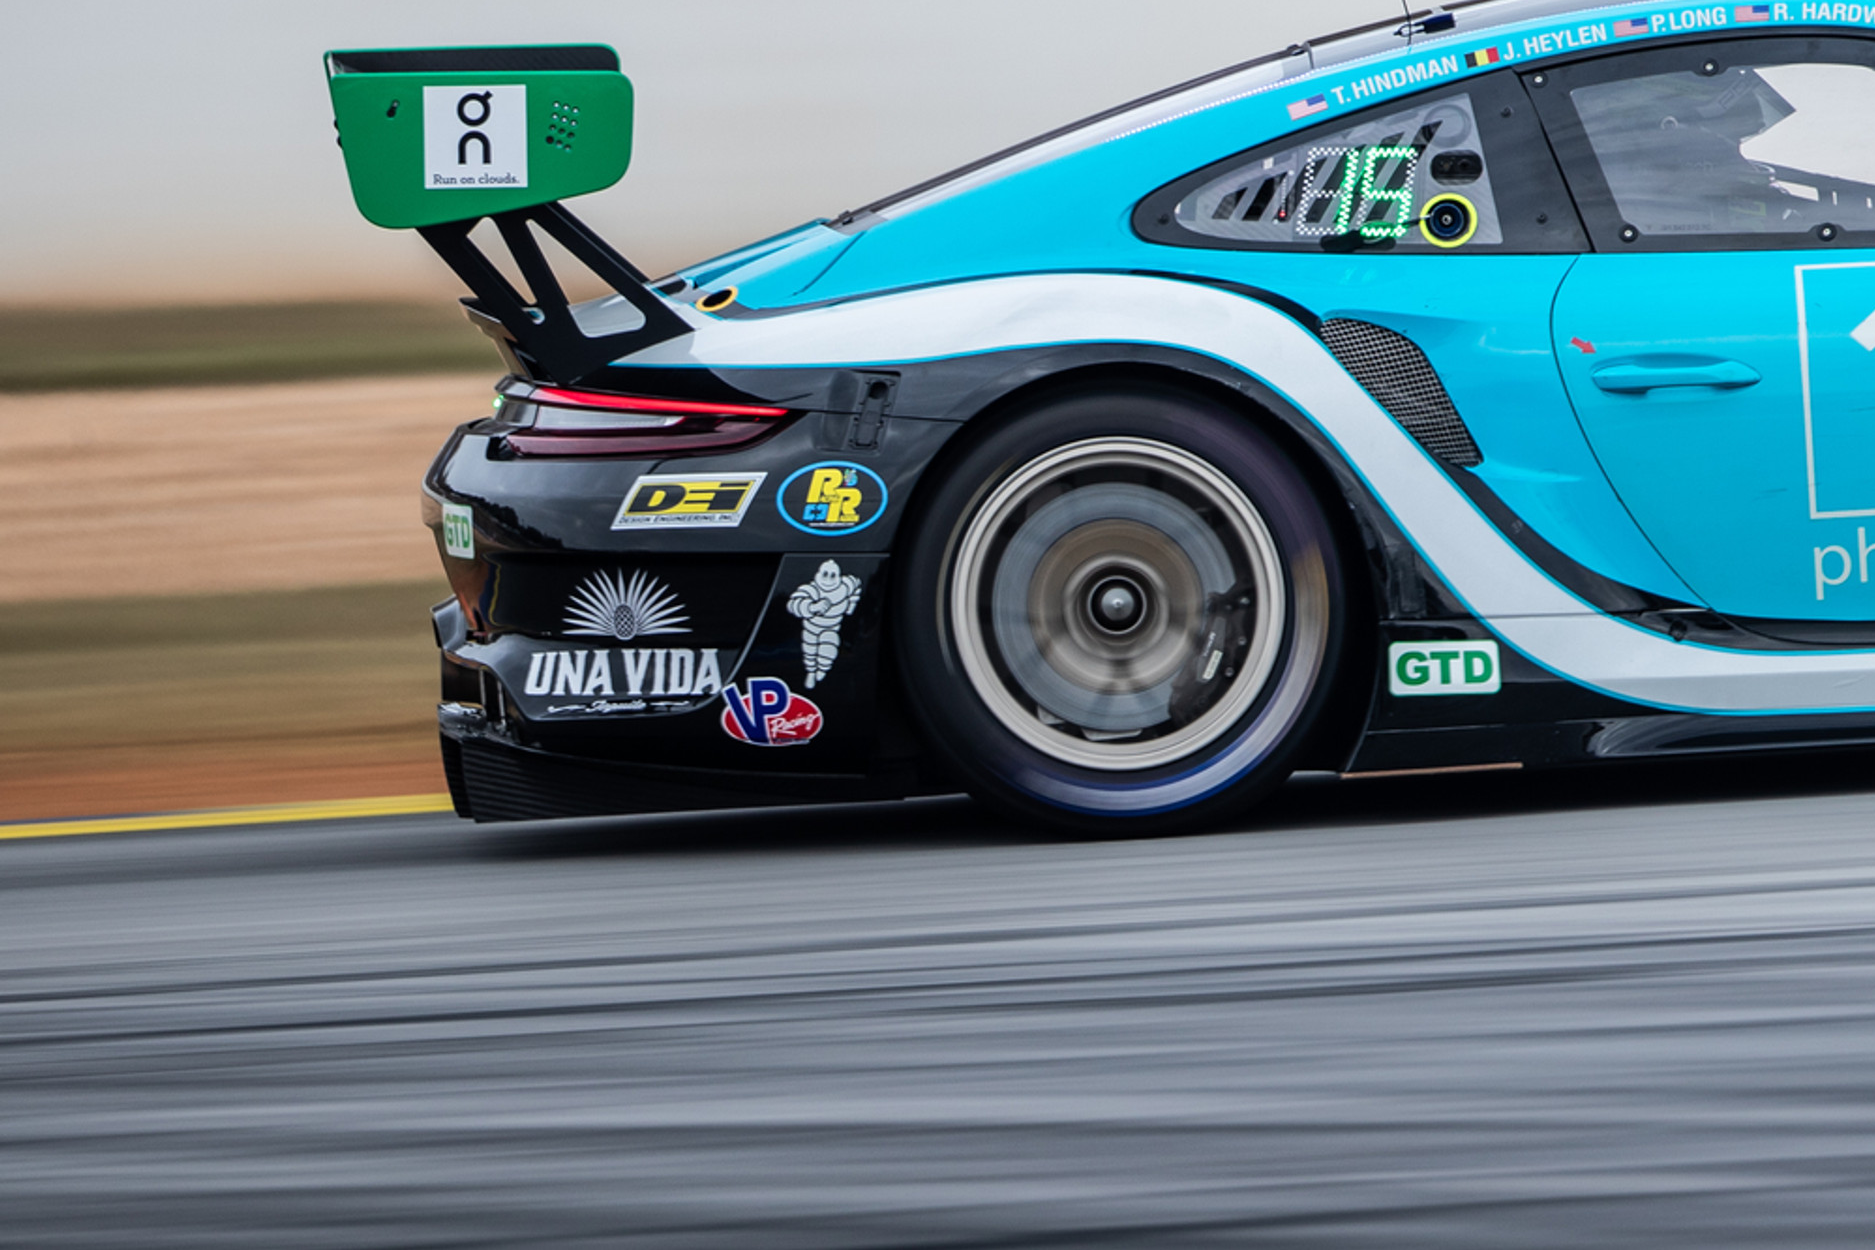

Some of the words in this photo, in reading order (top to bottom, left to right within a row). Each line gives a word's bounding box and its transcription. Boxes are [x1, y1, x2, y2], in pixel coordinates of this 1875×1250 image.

[1773, 2, 1794, 21] R.
[1524, 23, 1609, 58] HEYLEN
[1352, 54, 1460, 100] HINDMAN
[433, 173, 457, 185] Run
[461, 176, 476, 185] on
[478, 172, 520, 185] clouds.
[524, 650, 615, 696] UNA
[622, 648, 723, 696] VIDA
[1395, 650, 1494, 686] GTD
[721, 676, 791, 745] VP
[769, 711, 821, 739] Racing
